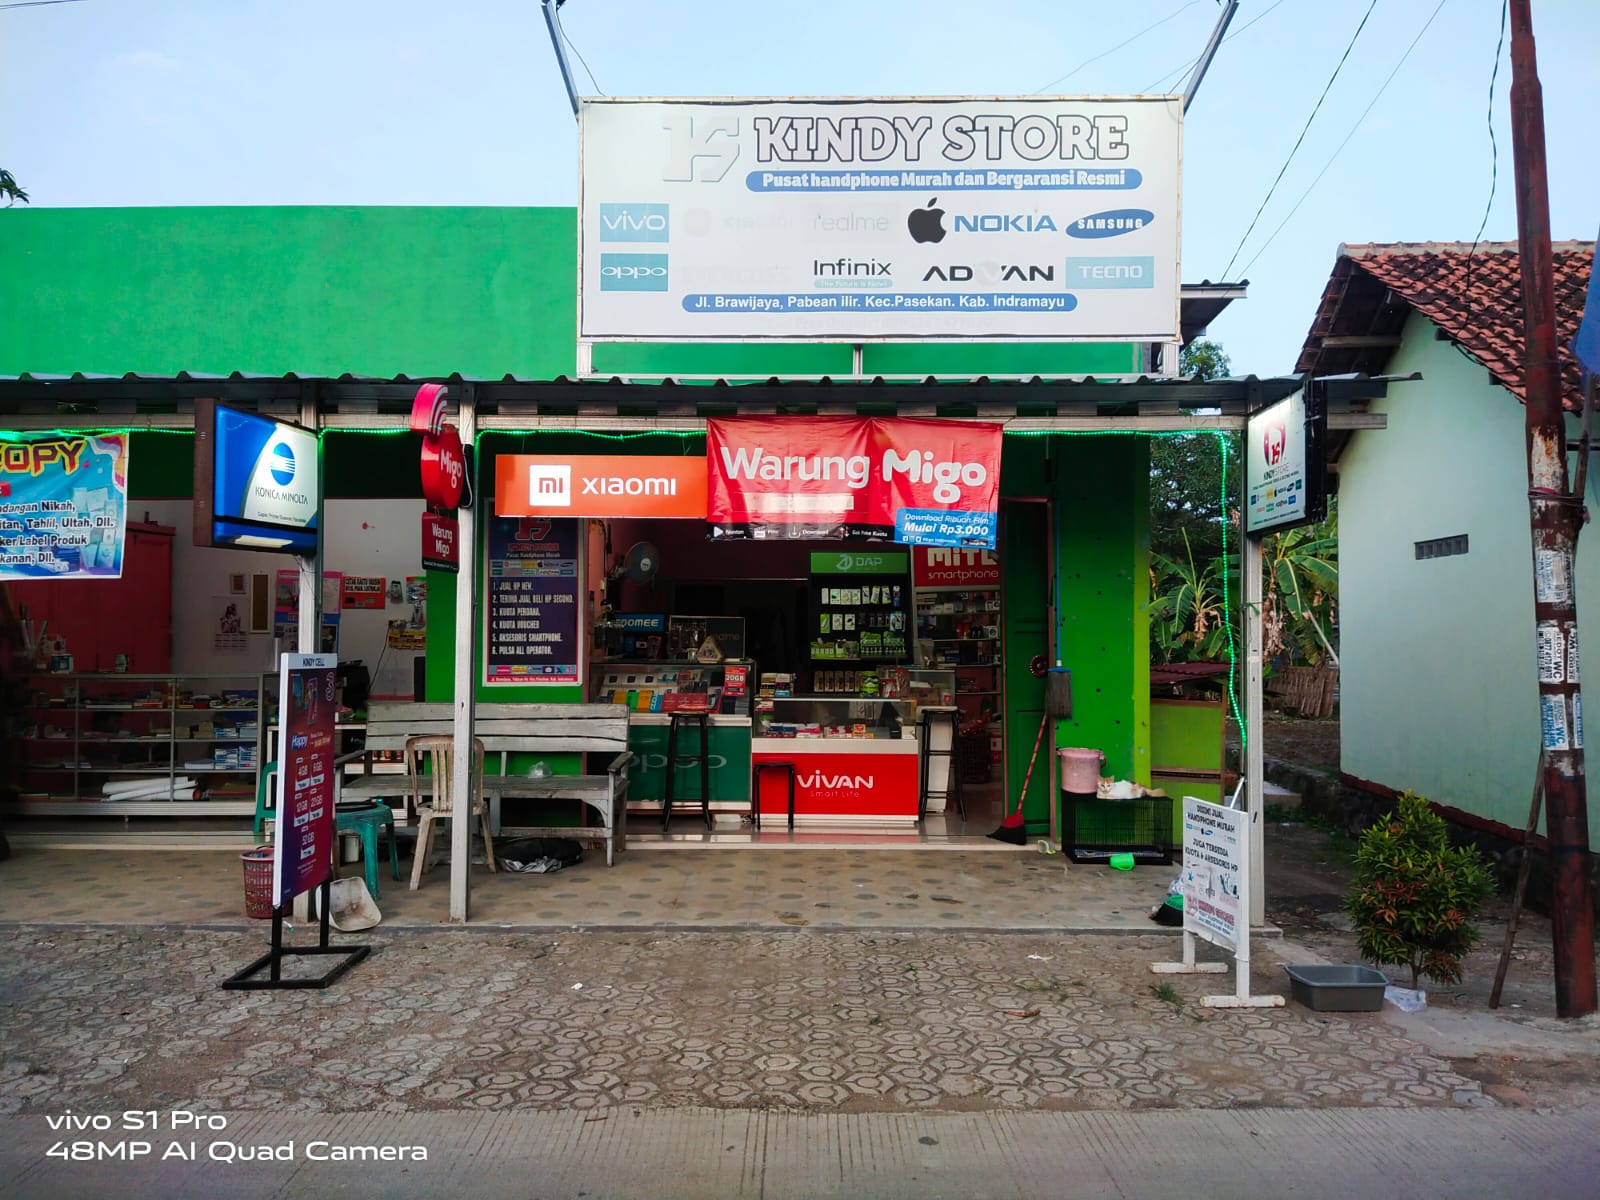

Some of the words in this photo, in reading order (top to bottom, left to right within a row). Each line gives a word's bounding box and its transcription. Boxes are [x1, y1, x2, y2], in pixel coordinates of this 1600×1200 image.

[753, 115, 933, 164] KINDY
[941, 114, 1130, 163] STORE
[763, 173, 808, 188] Pusat
[810, 172, 900, 190] handphone
[901, 172, 951, 187] Murah
[954, 171, 984, 186] dan
[986, 170, 1075, 189] Bergaransi
[1077, 170, 1126, 185] Resmi
[602, 210, 667, 232] vivo
[813, 211, 889, 232] realme
[953, 214, 1058, 233] NOKIA
[1077, 217, 1144, 230] SAMSUNG
[601, 266, 668, 280] oppo
[813, 258, 893, 277] Infinix
[1079, 265, 1143, 280] TECNO
[695, 295, 710, 309] Jl.
[715, 295, 784, 311] Brawijaya,
[788, 295, 837, 308] Pabean
[841, 295, 862, 308] ilir.
[865, 295, 955, 308] Kec.Pasekan.
[959, 295, 990, 308] Kab.
[993, 294, 1065, 310] Indramayu
[0, 442, 87, 477] OPY
[440, 448, 463, 488] Migo
[720, 446, 871, 489] Warung
[882, 448, 987, 504] Migo
[581, 477, 678, 496] xiaomi
[255, 486, 280, 500] KONICA
[281, 493, 309, 505] MINOLTA
[41, 502, 76, 513] Nikah,
[27, 518, 59, 530] Tahlil,
[62, 517, 93, 529] Ultah,
[96, 517, 114, 528] Dll.
[904, 513, 943, 522] Download
[945, 515, 971, 523] Ribuan
[972, 517, 990, 525] Film
[431, 522, 453, 544] Warung
[903, 522, 936, 533] Mulai
[939, 523, 990, 536] Rp3.000
[50, 535, 88, 546] Produk
[435, 539, 450, 559] Migo
[38, 553, 55, 564] Dll.
[927, 569, 999, 581] smartphone
[499, 581, 512, 591] JUAL
[513, 581, 521, 590] HP
[518, 594, 531, 603] JUAL
[532, 594, 544, 603] BELI
[544, 594, 552, 603] HP
[499, 607, 516, 616] KUOTA
[499, 620, 516, 629] KUOTA
[516, 620, 540, 630] VOUCHER
[499, 632, 527, 642] AKSESORIS
[498, 646, 515, 655] PULSA
[516, 646, 525, 655] ALL
[1552, 661, 1563, 679] WC
[1556, 726, 1566, 744] WC
[1187, 811, 1217, 828] HANDPHONE
[1217, 820, 1236, 834] MURAH
[1212, 808, 1225, 820] JUAL
[1193, 837, 1206, 849] JUGA
[1205, 842, 1229, 857] TERSEDIA
[1185, 846, 1200, 858] KUOTA
[1231, 862, 1240, 872] HP
